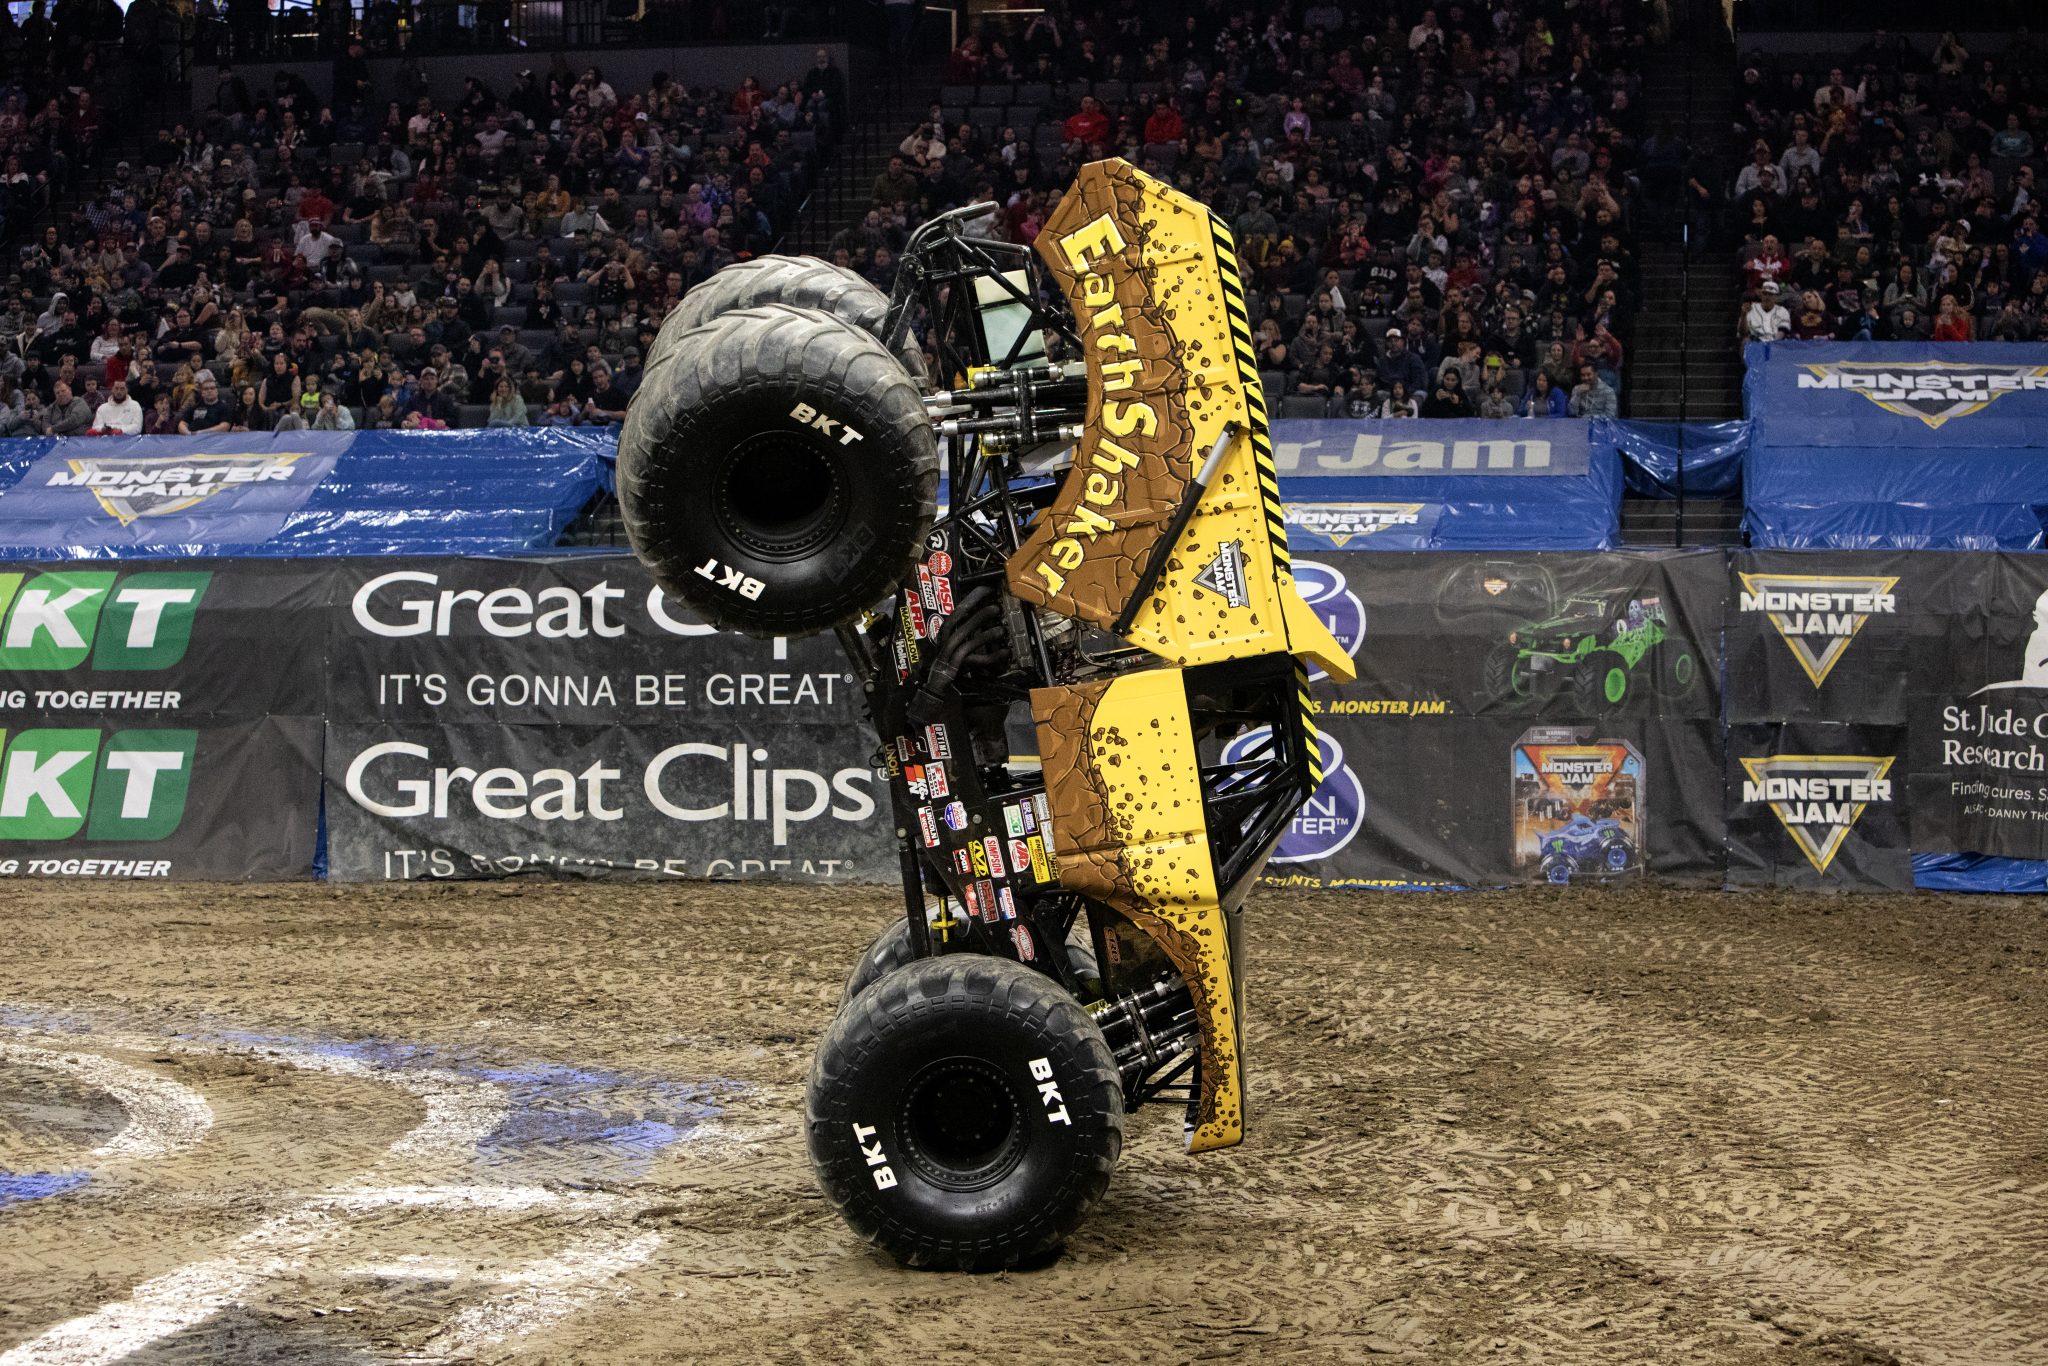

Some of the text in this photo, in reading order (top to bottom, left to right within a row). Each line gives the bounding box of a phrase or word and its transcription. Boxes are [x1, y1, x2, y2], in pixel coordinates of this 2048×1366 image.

[1798, 373, 2048, 390] MONSTER
[1035, 212, 1160, 598] EarthShaker
[789, 402, 864, 446] BKT
[1273, 433, 1552, 470] rJam
[45, 466, 296, 486] MONSTER
[99, 483, 215, 497] JAM
[1282, 513, 1419, 525] MONSTER
[1312, 523, 1378, 533] JAM
[693, 558, 767, 602] BKT
[1213, 561, 1228, 592] JAM
[1219, 542, 1240, 609] MONSTER
[352, 570, 625, 639] Great
[923, 582, 934, 608] KING
[937, 577, 954, 614] MSD
[1739, 592, 1895, 613] MONSTER
[5, 588, 197, 648] KT
[908, 589, 926, 638] ARP
[1783, 613, 1852, 635] JAM
[901, 607, 918, 662] MAGNAFLOW
[895, 641, 909, 670] Holley
[35, 690, 181, 709] TOGETHER
[466, 673, 616, 706] GONNA
[635, 674, 686, 706] BE
[1330, 700, 1410, 714] MONSTER
[1943, 706, 1976, 732] St.
[1977, 705, 2027, 737] Jude
[935, 726, 947, 756] OPTIMA
[1942, 739, 2045, 771] Research
[885, 744, 900, 777] UNOH
[1541, 762, 1614, 773] MONSTER
[0, 750, 185, 819] KT
[346, 741, 624, 821] Great
[935, 767, 946, 794] FK
[1561, 773, 1594, 784] JAM
[1743, 777, 1892, 803] MONSTER
[1951, 780, 1990, 798] Finding
[1991, 787, 2034, 801] cures.
[926, 808, 937, 839] LINCOLN
[1785, 801, 1850, 824] JAM
[1964, 803, 1984, 815] ALSAC
[1988, 807, 2028, 820] DANNY
[922, 816, 931, 843] WELDERS
[28, 859, 172, 877] TOGETHER
[987, 839, 1002, 874] SIMPSON
[1015, 840, 1030, 868] JAZ
[1028, 1057, 1072, 1127] BKT
[852, 1122, 899, 1190] BKT
